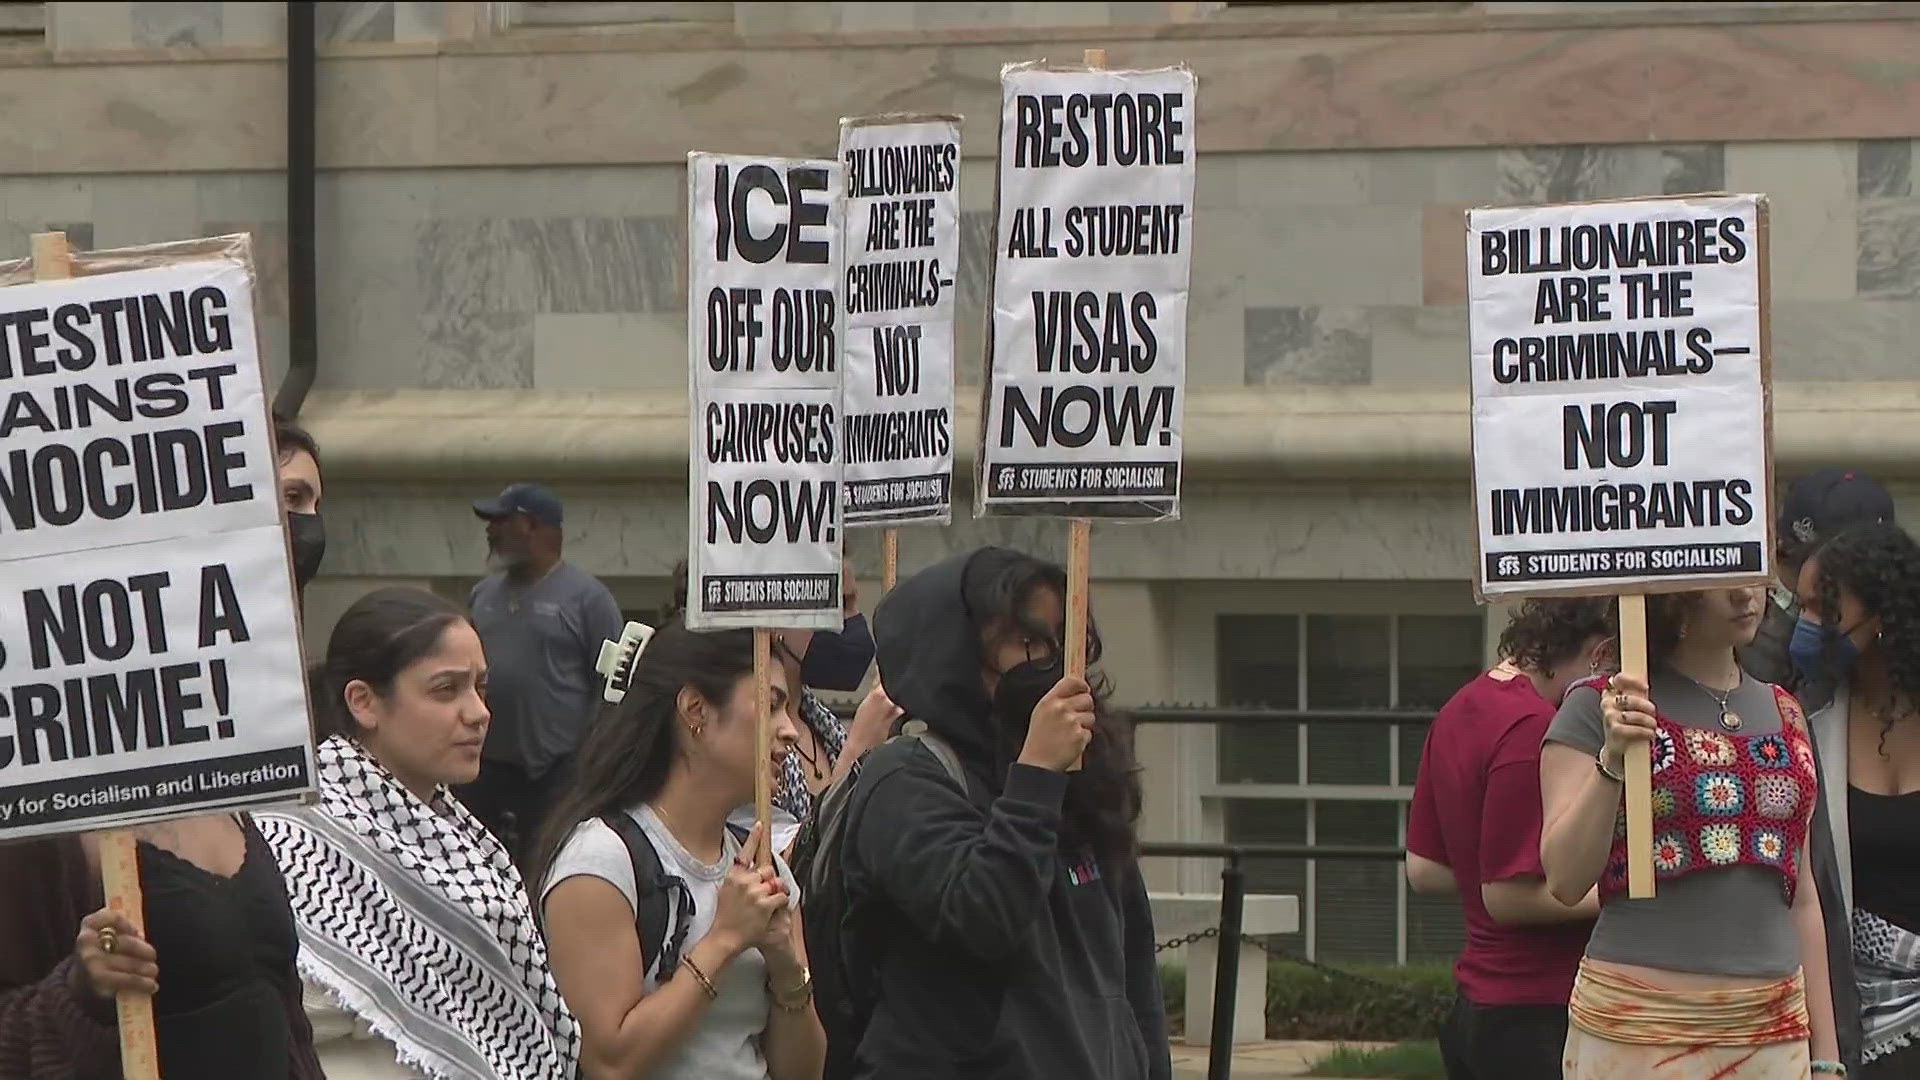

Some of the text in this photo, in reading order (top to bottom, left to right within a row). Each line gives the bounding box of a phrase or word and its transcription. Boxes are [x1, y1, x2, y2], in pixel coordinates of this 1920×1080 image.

[1014, 92, 1184, 168] RESTORE
[846, 143, 957, 198] BILLIONAIRES
[713, 163, 830, 264] ICE
[865, 198, 935, 252] ARE THE
[1007, 204, 1184, 258] ALL STUDENT
[1481, 216, 1747, 277] BILLIONAIRES
[1534, 271, 1694, 325] ARE THE
[707, 286, 835, 373] OFF OUR
[1032, 290, 1157, 374] VISAS
[873, 325, 922, 397] NOT
[0, 363, 238, 438] AINST
[999, 384, 1175, 448] NOW!
[706, 401, 834, 465] CAMPUSES
[1562, 400, 1677, 470] NOT
[889, 481, 906, 502] FOR
[1019, 468, 1079, 491] STUDENTS
[1079, 468, 1103, 489] FOR
[1104, 467, 1165, 489] SOCIALISM
[1490, 478, 1753, 537] IMMIGRANTS
[706, 479, 836, 545] NOW!
[724, 580, 766, 602] STUDENTS
[766, 580, 783, 602] FOR
[784, 579, 830, 601] SOCIALISM
[1528, 552, 1611, 574] STUDENTS
[1615, 551, 1646, 570] FOR
[1651, 547, 1742, 569] SOCIALISM
[22, 563, 250, 670] NOT A
[18, 797, 48, 815] for
[52, 782, 151, 811] Socialism
[155, 774, 194, 797] and
[199, 763, 301, 790] Liberation
